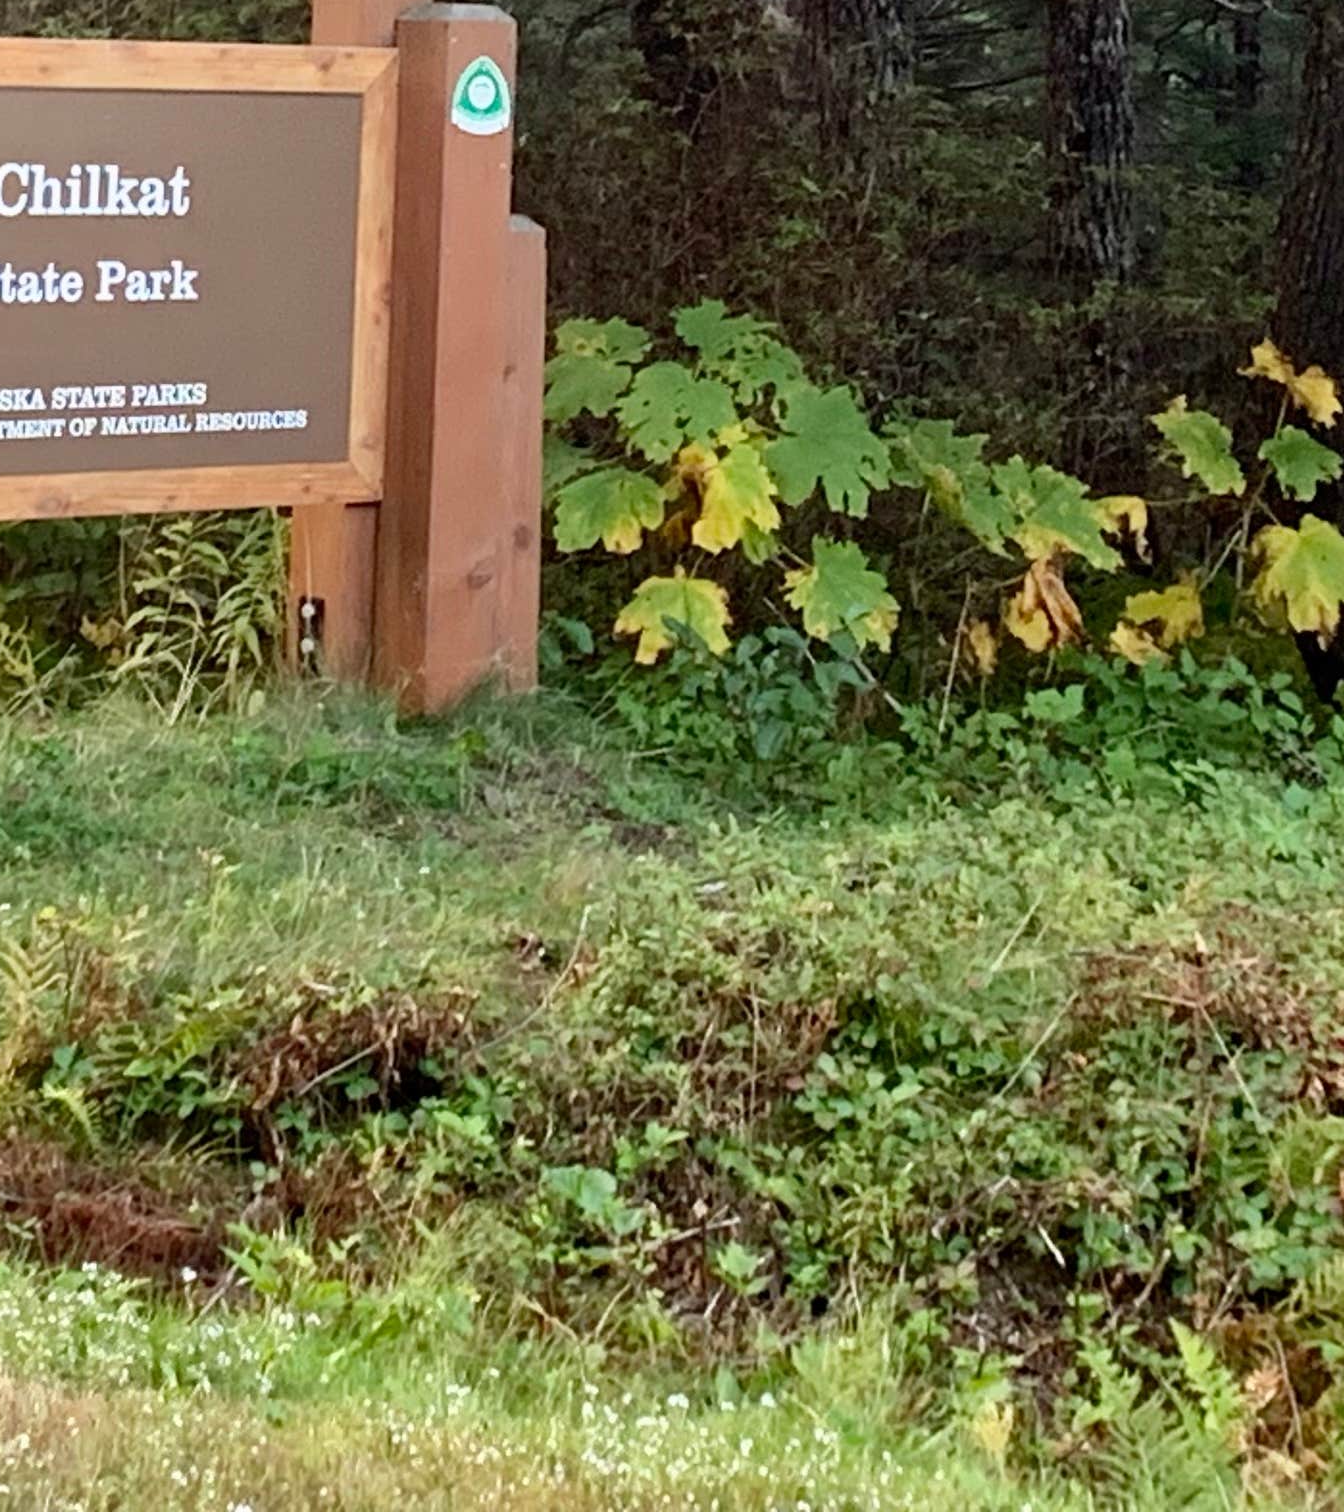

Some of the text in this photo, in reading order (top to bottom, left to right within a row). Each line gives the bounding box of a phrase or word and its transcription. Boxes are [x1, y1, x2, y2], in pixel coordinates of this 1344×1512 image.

[95, 260, 199, 302] Park
[51, 385, 126, 409] STATE
[131, 382, 207, 406] PARKS
[69, 415, 98, 437] OF
[100, 414, 192, 435] NATURAL
[195, 409, 308, 432] RESOURCES
